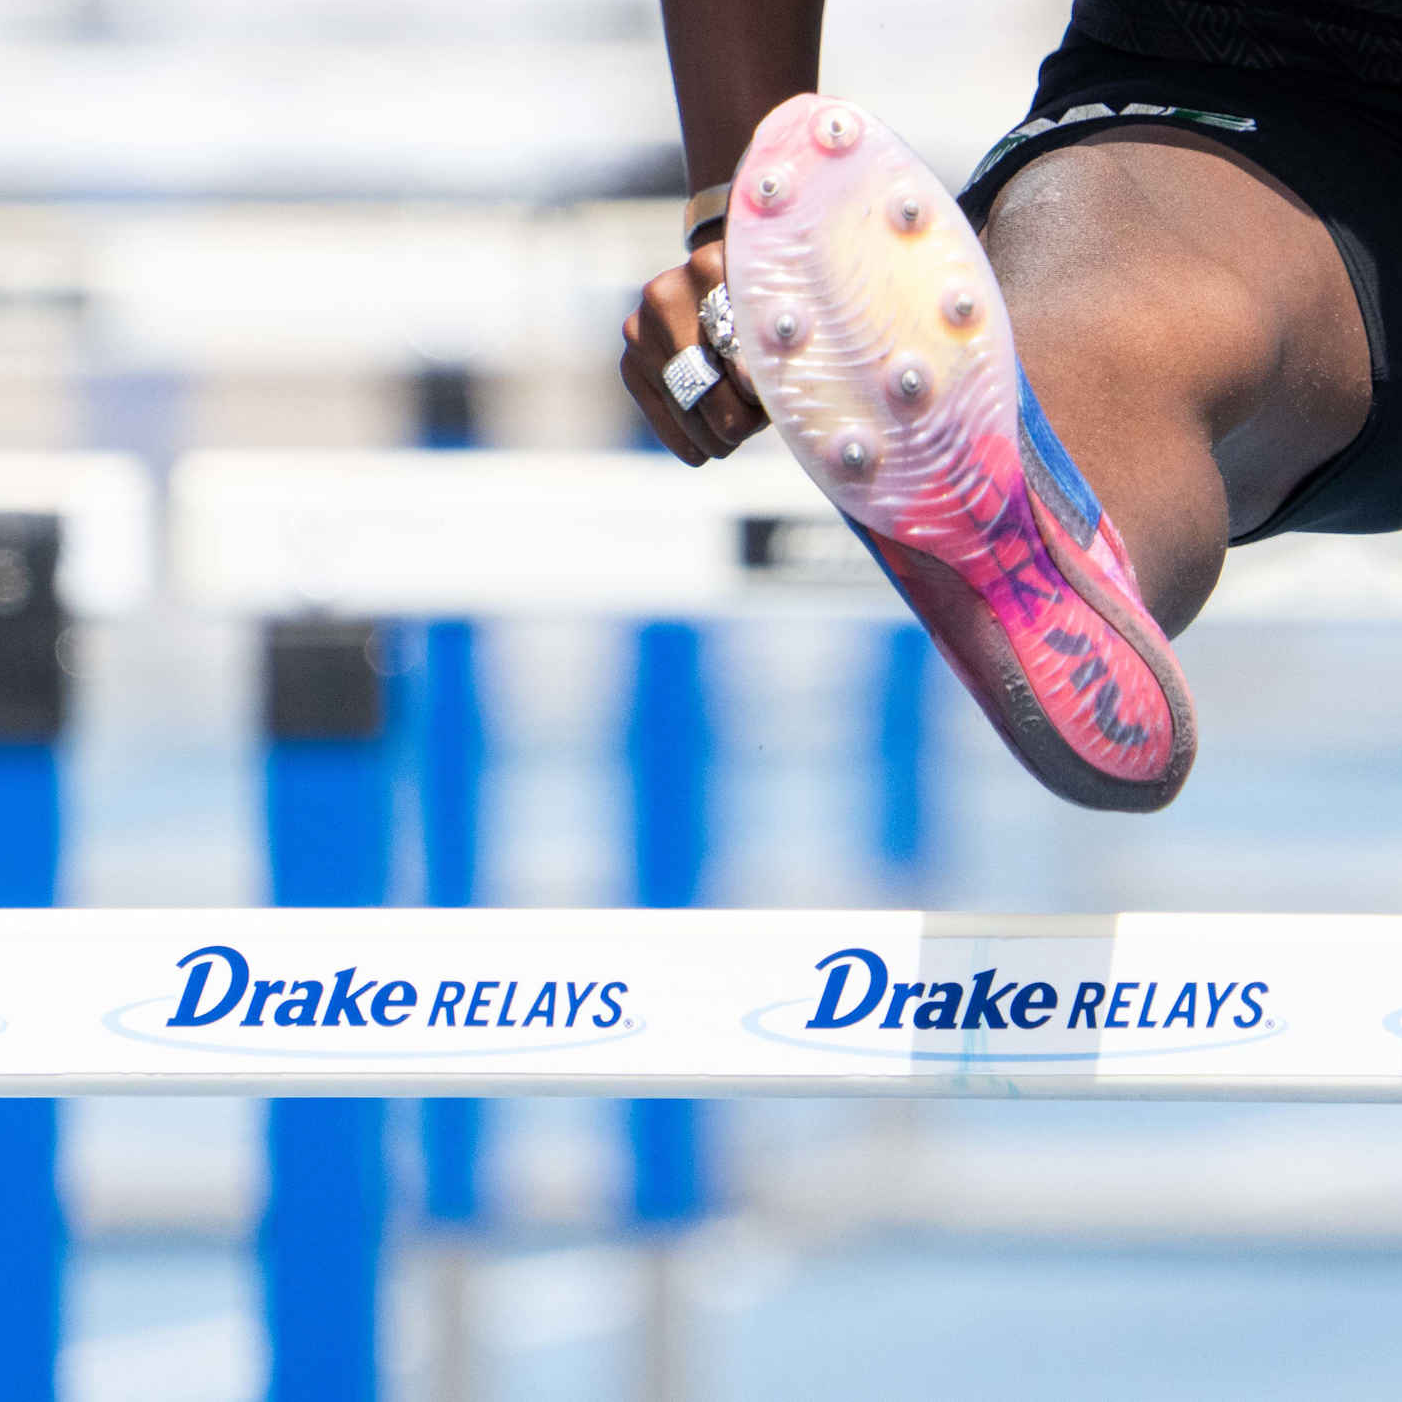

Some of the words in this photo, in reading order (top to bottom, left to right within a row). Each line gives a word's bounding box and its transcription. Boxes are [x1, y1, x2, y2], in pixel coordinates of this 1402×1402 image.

[166, 945, 418, 1028] Drake
[427, 981, 629, 1029] RELAYS
[805, 948, 1059, 1030] Drake
[1066, 981, 1269, 1029] RELAYS
